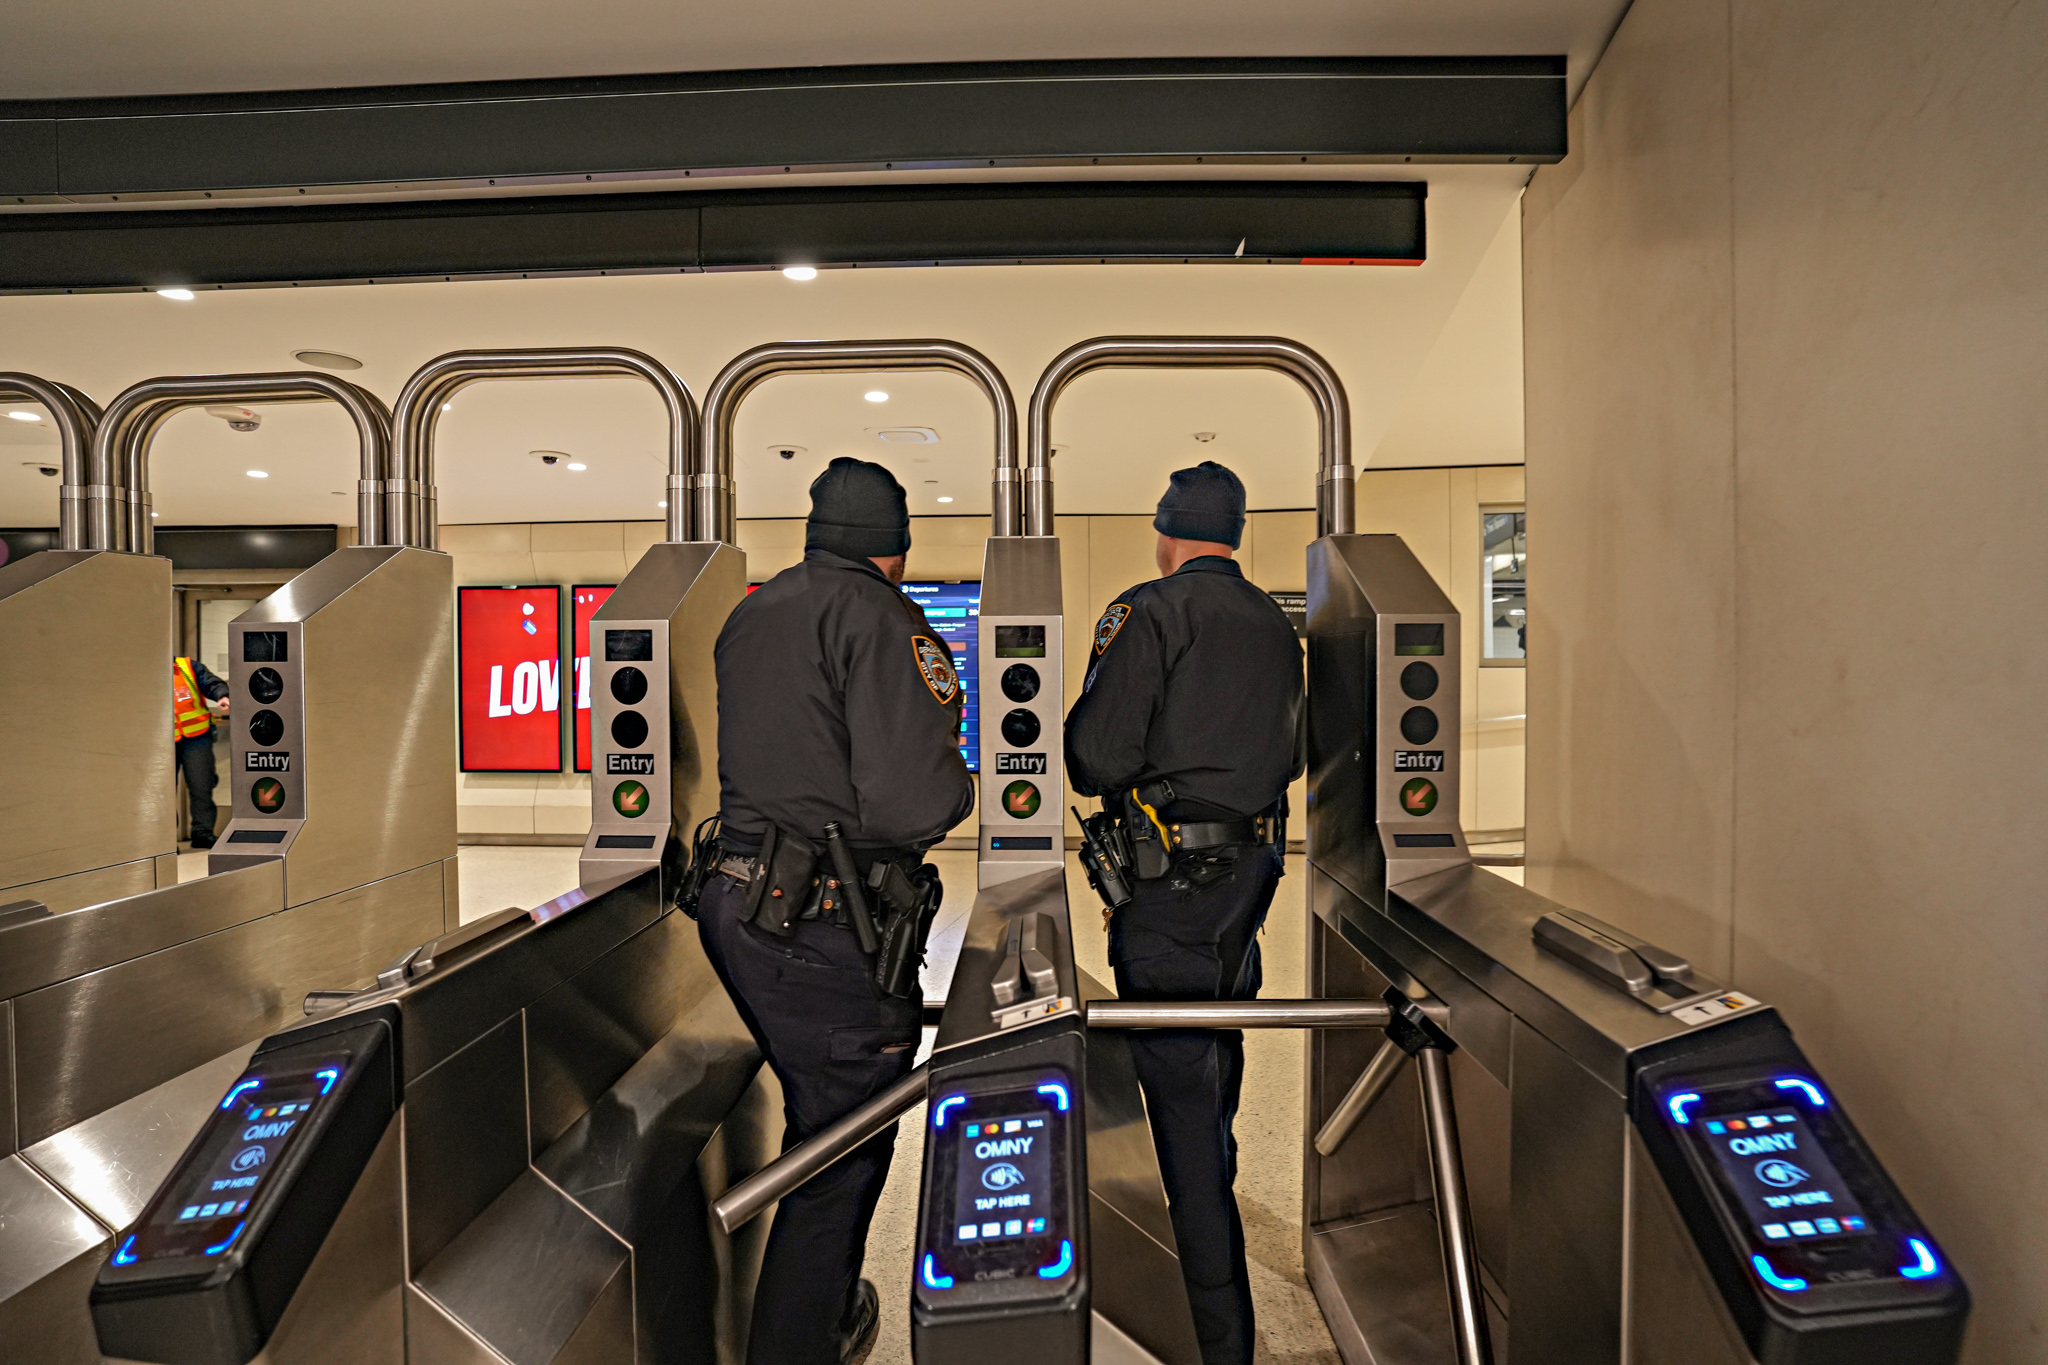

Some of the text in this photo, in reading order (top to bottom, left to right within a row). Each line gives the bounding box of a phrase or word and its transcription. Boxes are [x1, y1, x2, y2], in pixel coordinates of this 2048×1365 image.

[1286, 598, 1306, 606] ramp
[247, 752, 290, 771] Entry
[608, 755, 654, 775] Entry
[997, 754, 1045, 774] Entry
[1394, 751, 1443, 772] Entry
[243, 1120, 296, 1141] OMNY
[975, 1136, 1034, 1160] OMNY
[1728, 1131, 1798, 1156] OMNY
[211, 1175, 259, 1191] TAP HERE
[975, 1193, 1031, 1210] TAP HERE
